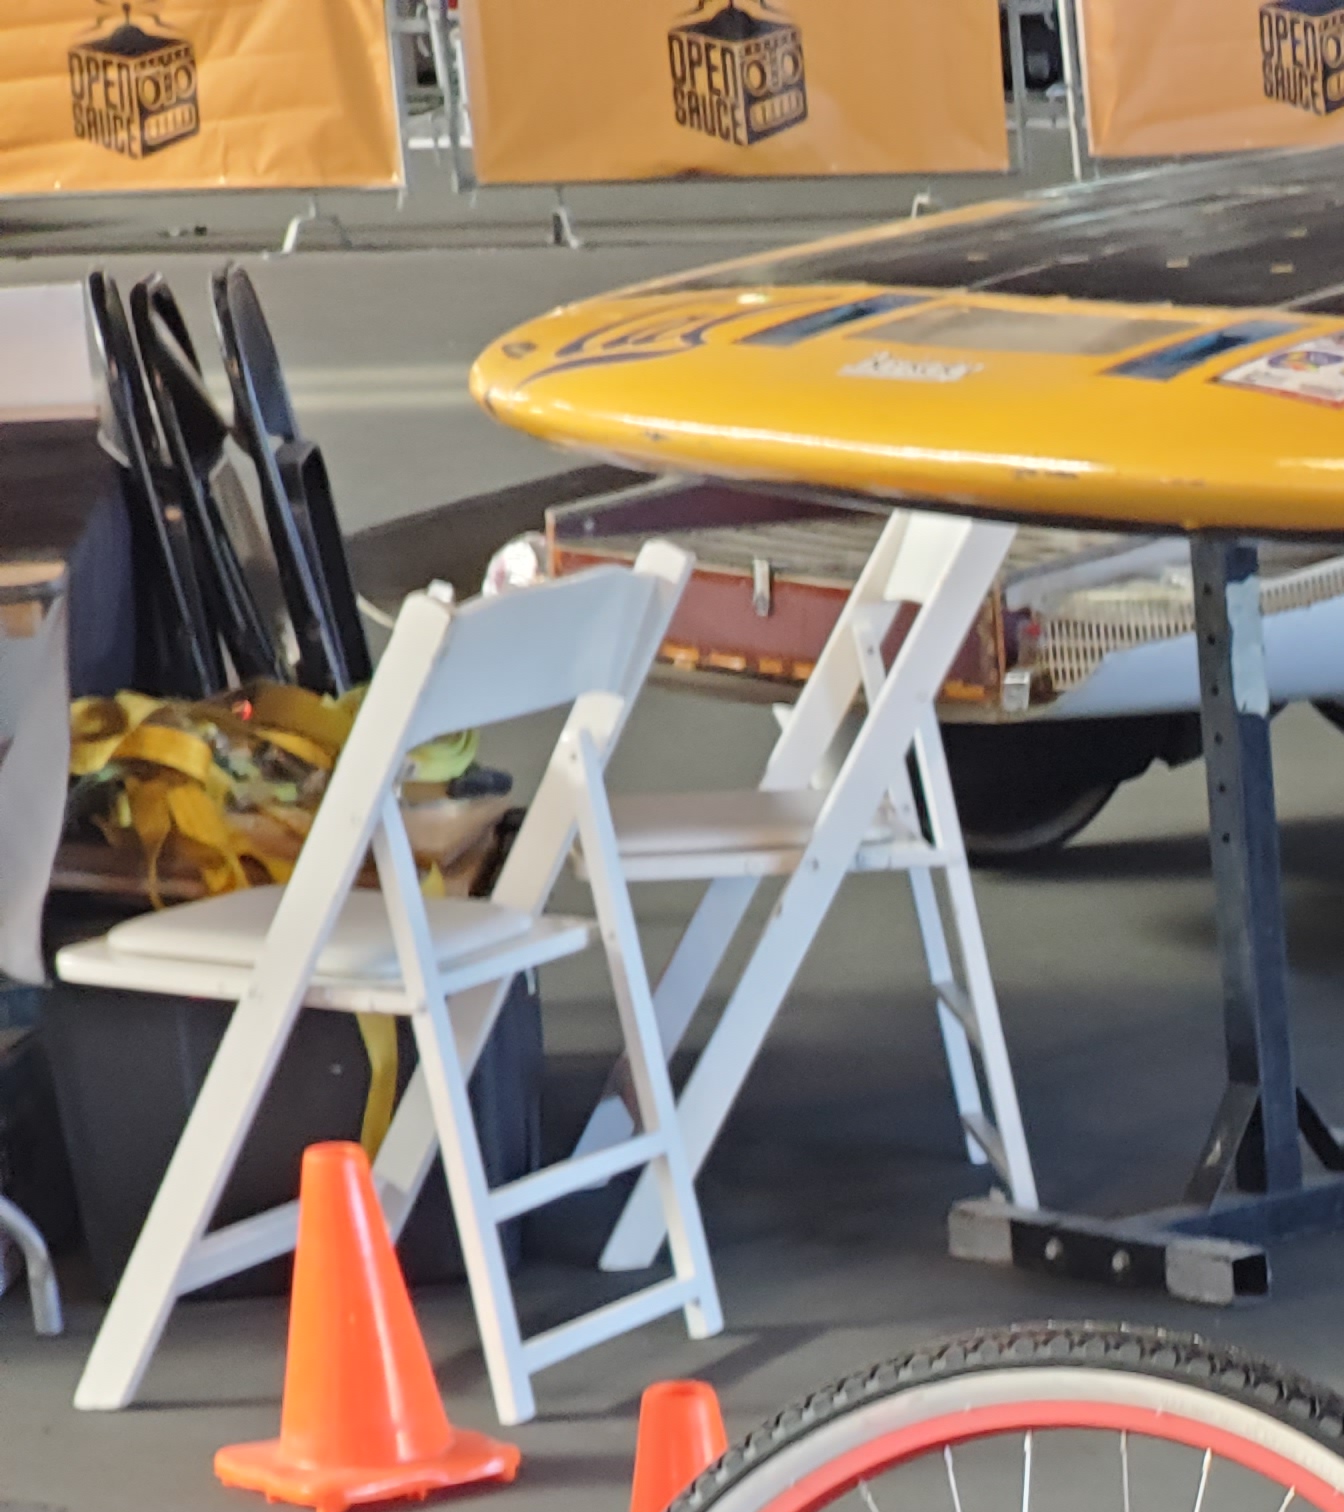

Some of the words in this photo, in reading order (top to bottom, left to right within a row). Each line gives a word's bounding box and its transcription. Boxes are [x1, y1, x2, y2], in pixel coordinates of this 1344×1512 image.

[667, 32, 739, 101] OPEN
[1259, 8, 1319, 74] OPEN
[69, 51, 134, 116] OPEN
[673, 84, 745, 147] SAUCE
[1263, 54, 1324, 116] SAUCE
[72, 102, 140, 160] SAUCE
